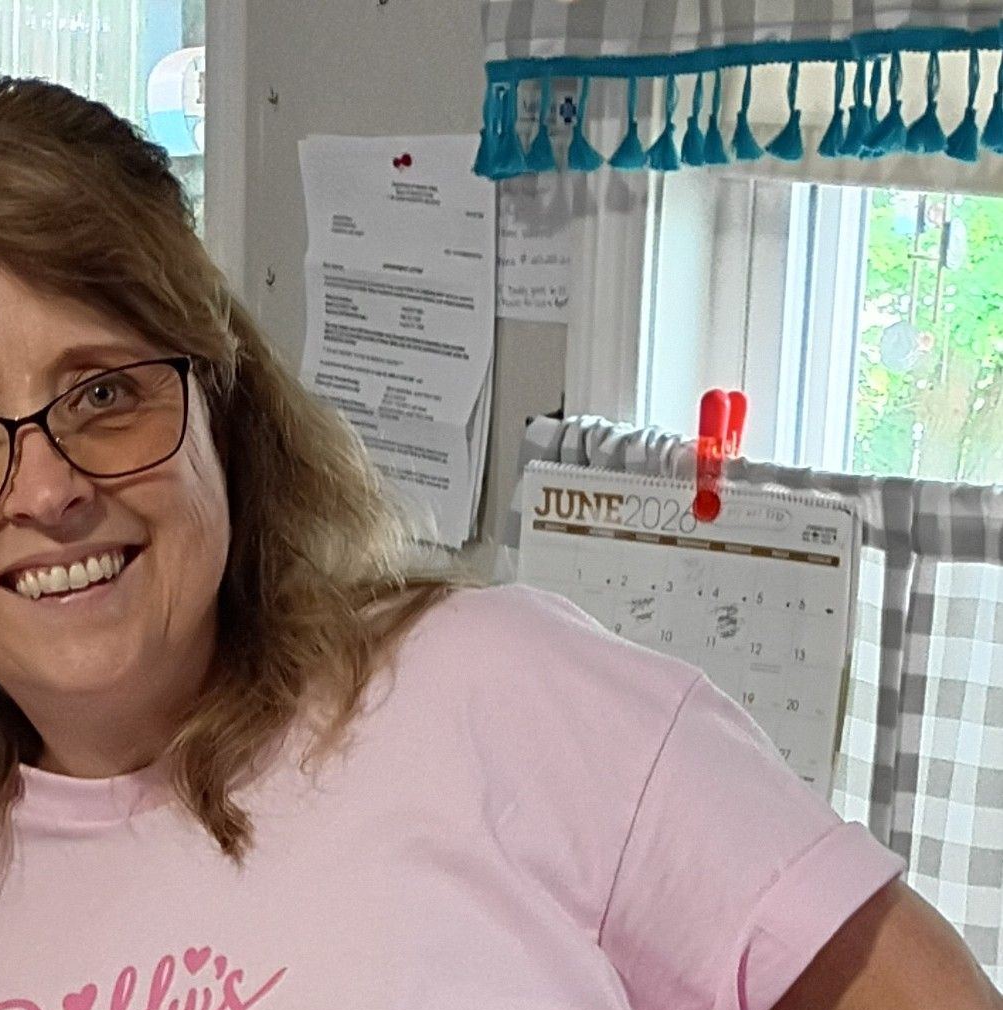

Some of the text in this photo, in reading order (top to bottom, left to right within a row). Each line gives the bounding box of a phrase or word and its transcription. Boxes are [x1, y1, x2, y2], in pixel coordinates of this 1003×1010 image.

[534, 486, 698, 534] JUNE 2026
[620, 574, 628, 587] 2
[665, 580, 674, 593] 3
[712, 586, 719, 598] 4
[614, 622, 806, 661] 9 10 11 12 13
[742, 691, 800, 712] 19 20
